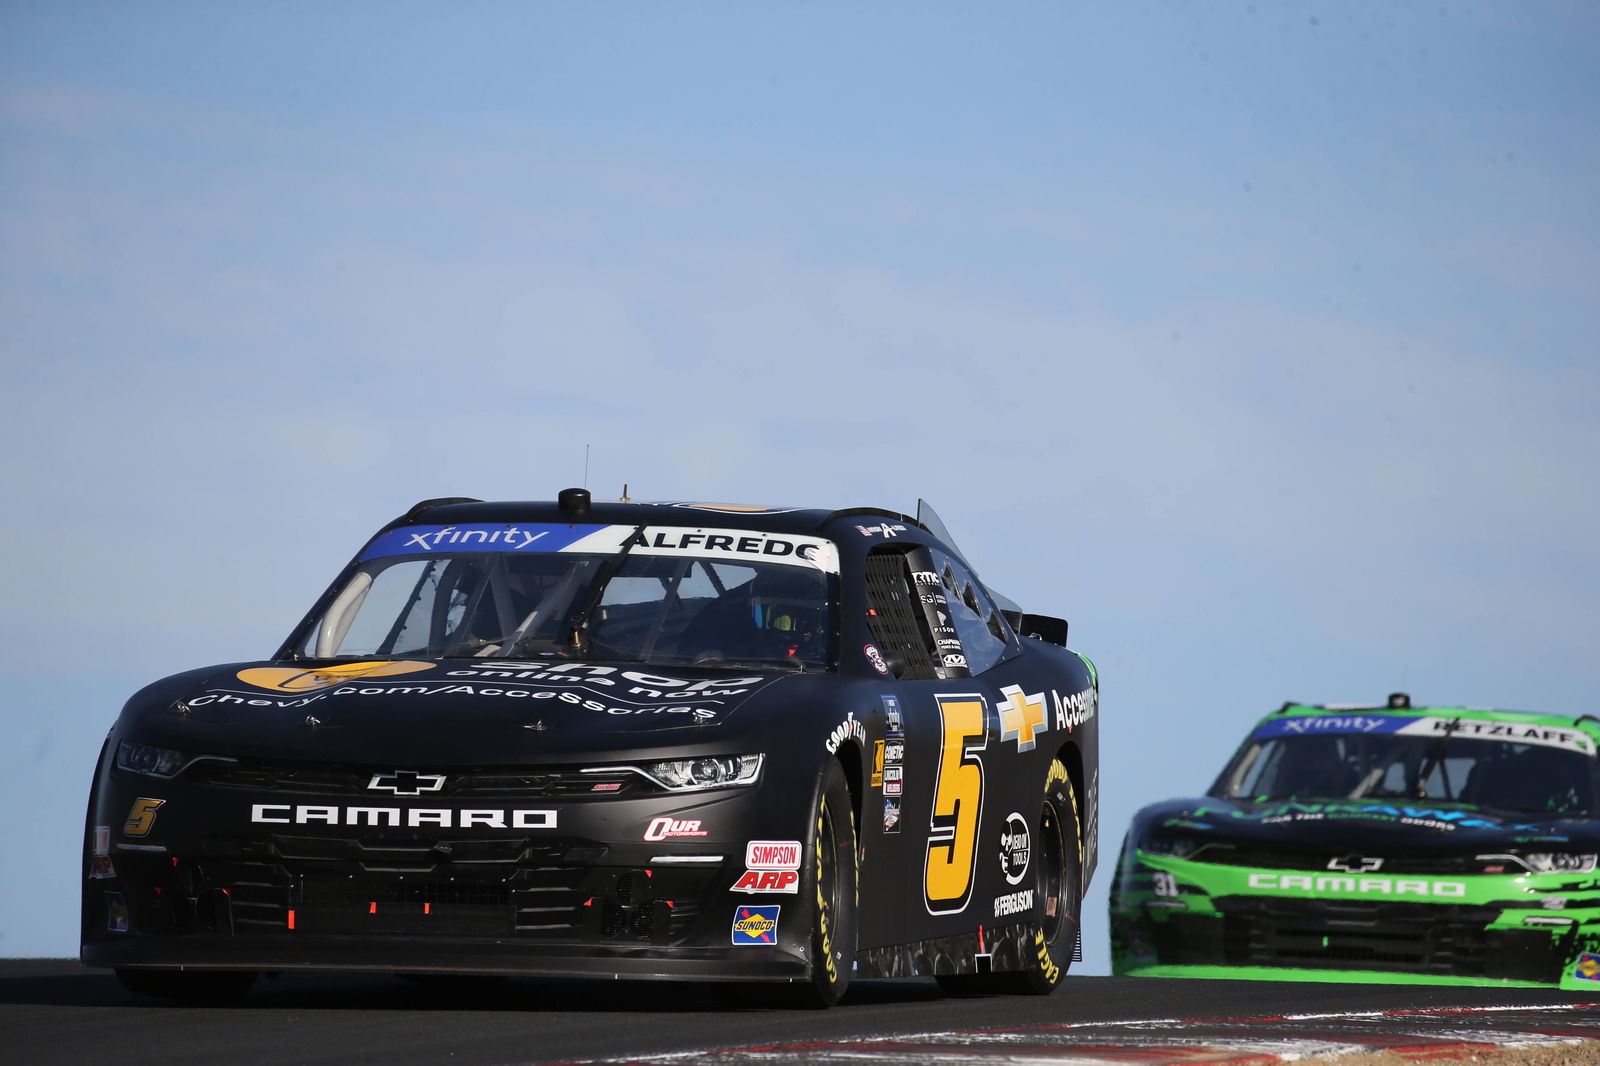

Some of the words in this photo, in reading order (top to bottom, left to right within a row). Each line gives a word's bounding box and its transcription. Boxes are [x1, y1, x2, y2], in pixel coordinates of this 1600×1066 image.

[402, 527, 550, 550] xfinity
[446, 669, 616, 686] online
[628, 686, 749, 700] now
[825, 712, 867, 755] GOODYEAR
[1284, 716, 1386, 734] xfinity
[1433, 719, 1576, 743] RETZLAFF
[123, 796, 167, 838] 5
[251, 803, 558, 829] CAMARO
[923, 693, 989, 916] 5
[751, 846, 797, 864] SIMPSON
[734, 871, 798, 889] ARP
[1152, 871, 1179, 897] 31
[1248, 873, 1466, 897] CAMARO
[1000, 890, 1034, 917] FERGUSON
[736, 920, 773, 931] SUNOCO
[1035, 928, 1060, 985] EAGLE
